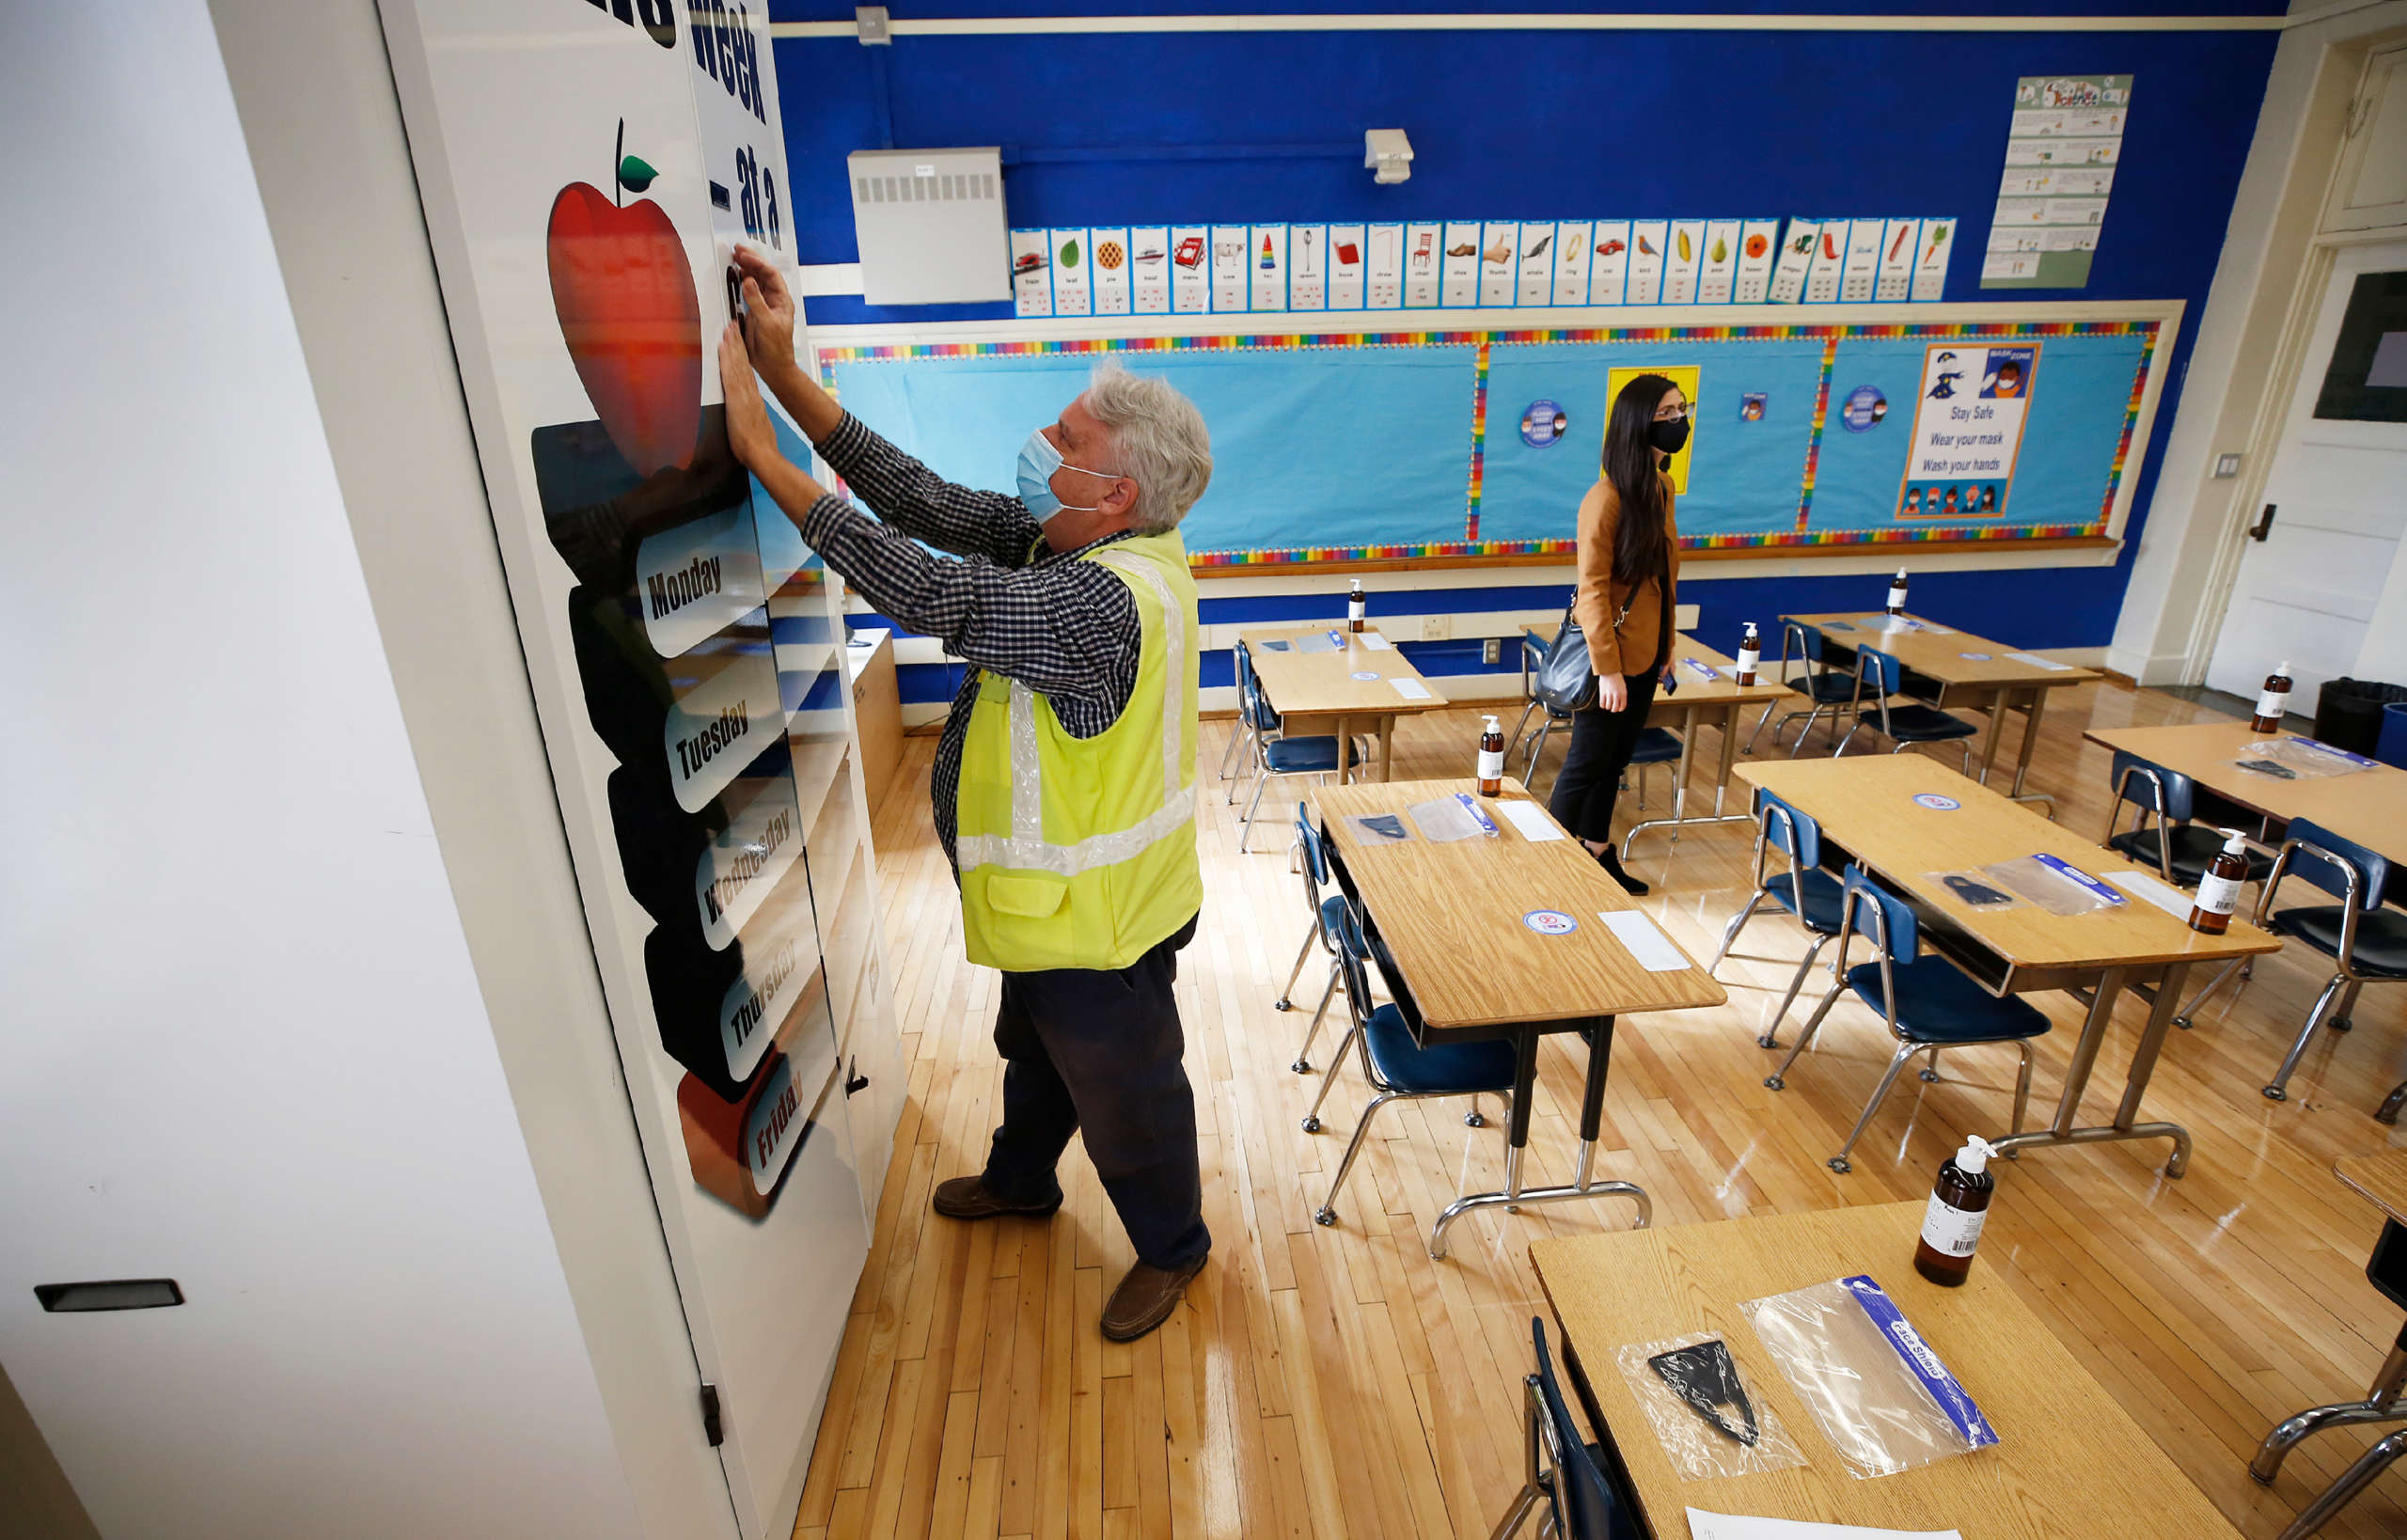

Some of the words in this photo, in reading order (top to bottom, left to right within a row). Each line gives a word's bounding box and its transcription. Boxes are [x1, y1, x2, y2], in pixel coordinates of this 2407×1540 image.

[735, 144, 766, 244] at
[763, 167, 782, 251] a
[1930, 432, 1955, 446] Wear
[1955, 435, 1977, 448] your
[1979, 432, 2004, 445] mask
[1951, 405, 1971, 423] Stay
[1974, 405, 1994, 419] Safe
[1923, 459, 1948, 471] Wash
[1948, 460, 1972, 474] your
[1973, 458, 2001, 471] hands
[647, 555, 721, 621] Monday
[676, 699, 749, 781] Tuesday
[703, 808, 791, 926] Wednesday
[731, 938, 796, 1048] Thursday
[757, 1070, 803, 1171] Friday
